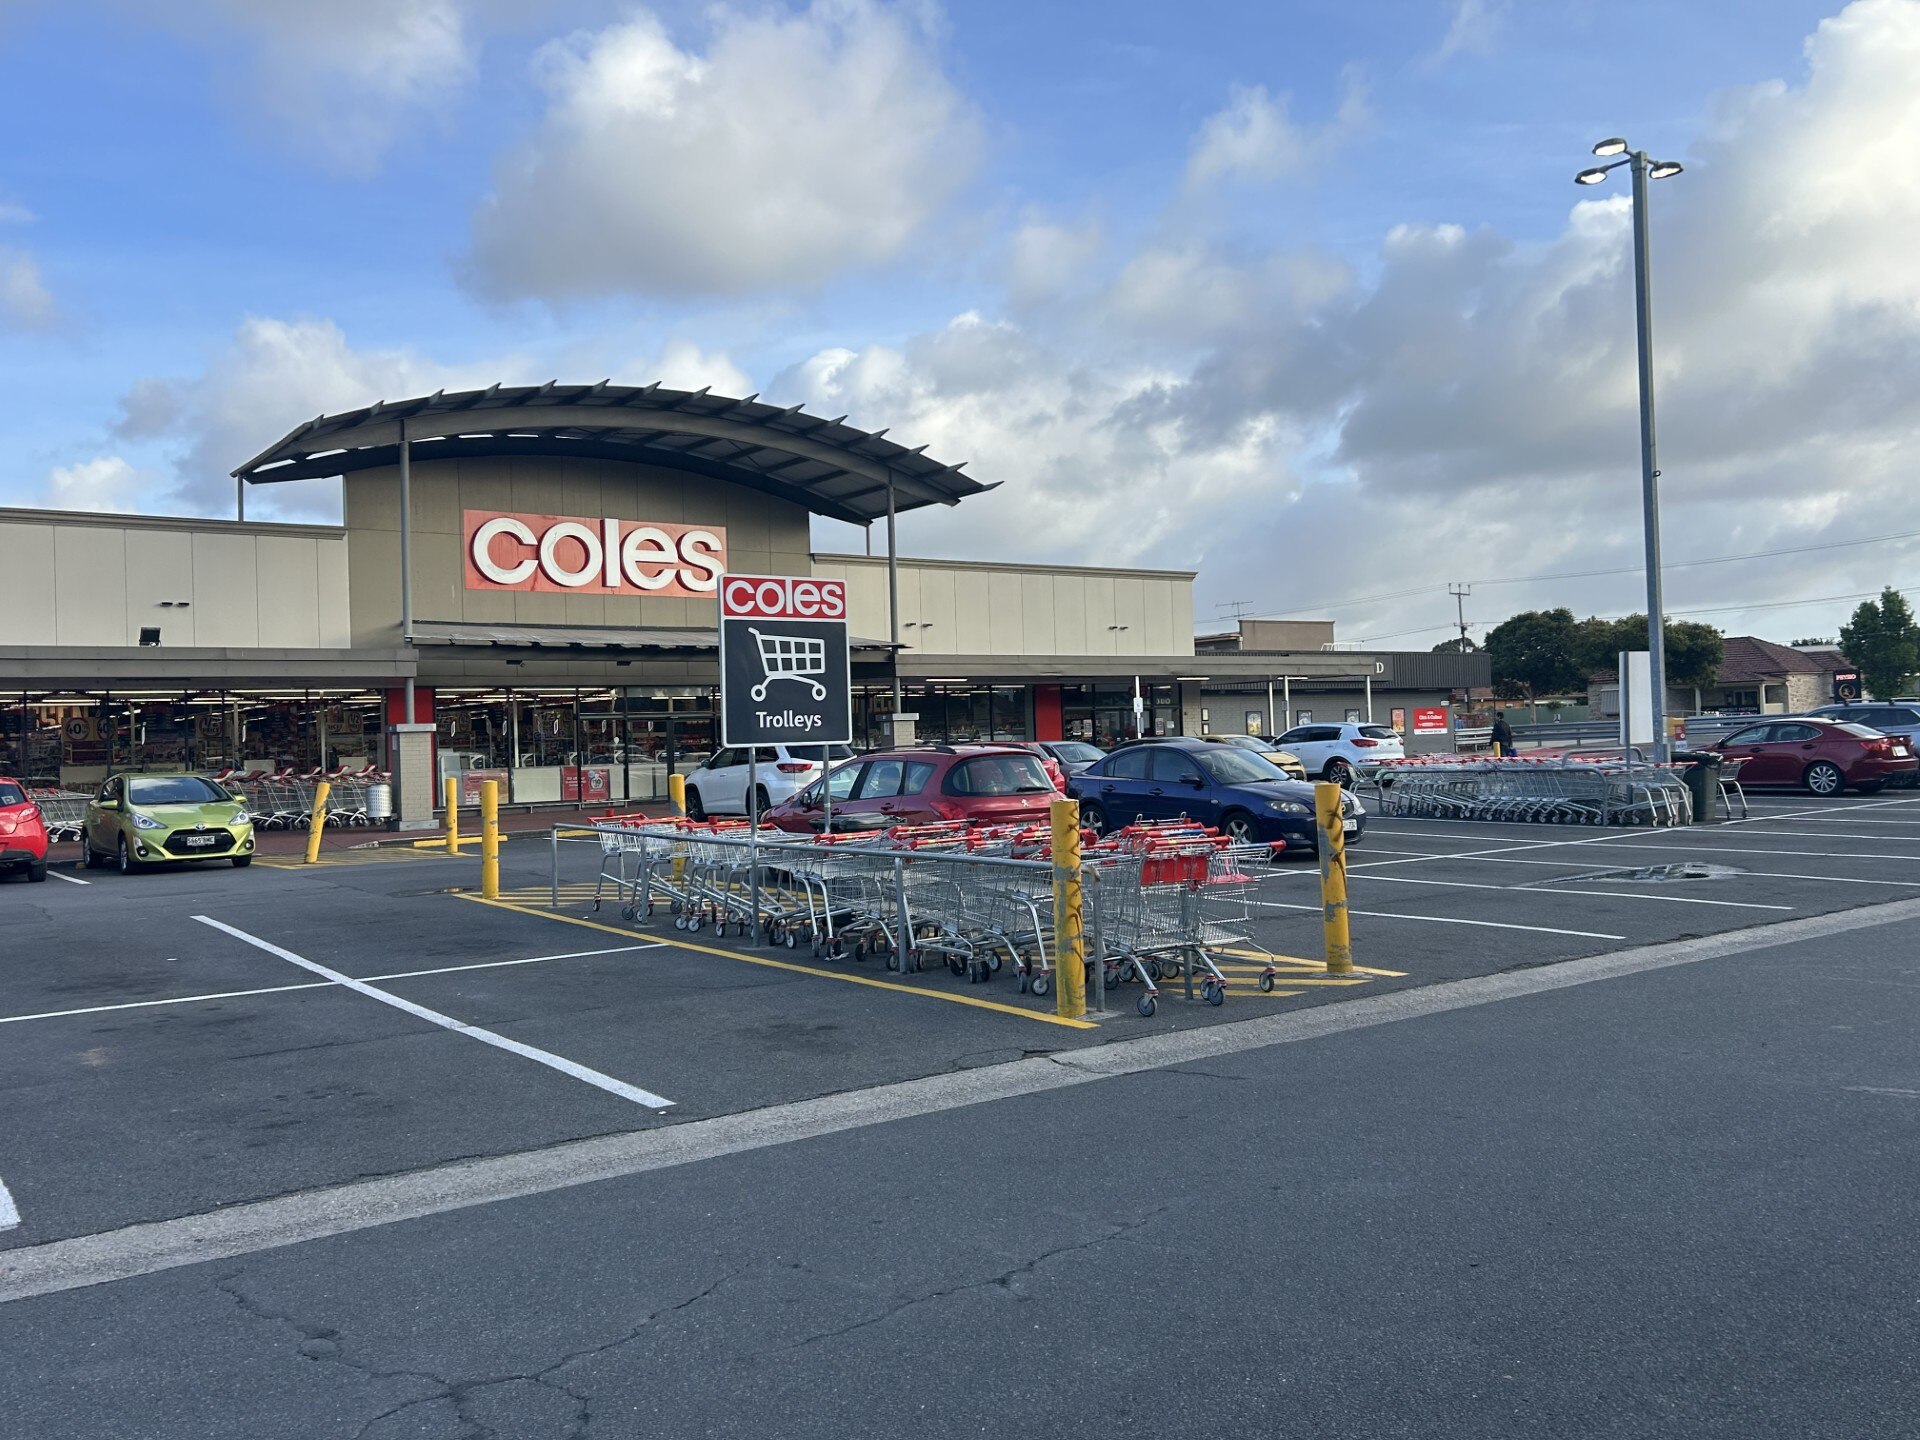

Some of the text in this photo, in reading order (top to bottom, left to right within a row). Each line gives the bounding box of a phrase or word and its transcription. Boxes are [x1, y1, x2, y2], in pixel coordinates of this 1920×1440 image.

[471, 517, 725, 591] coles
[725, 579, 844, 616] coles
[755, 710, 822, 732] Trolleys
